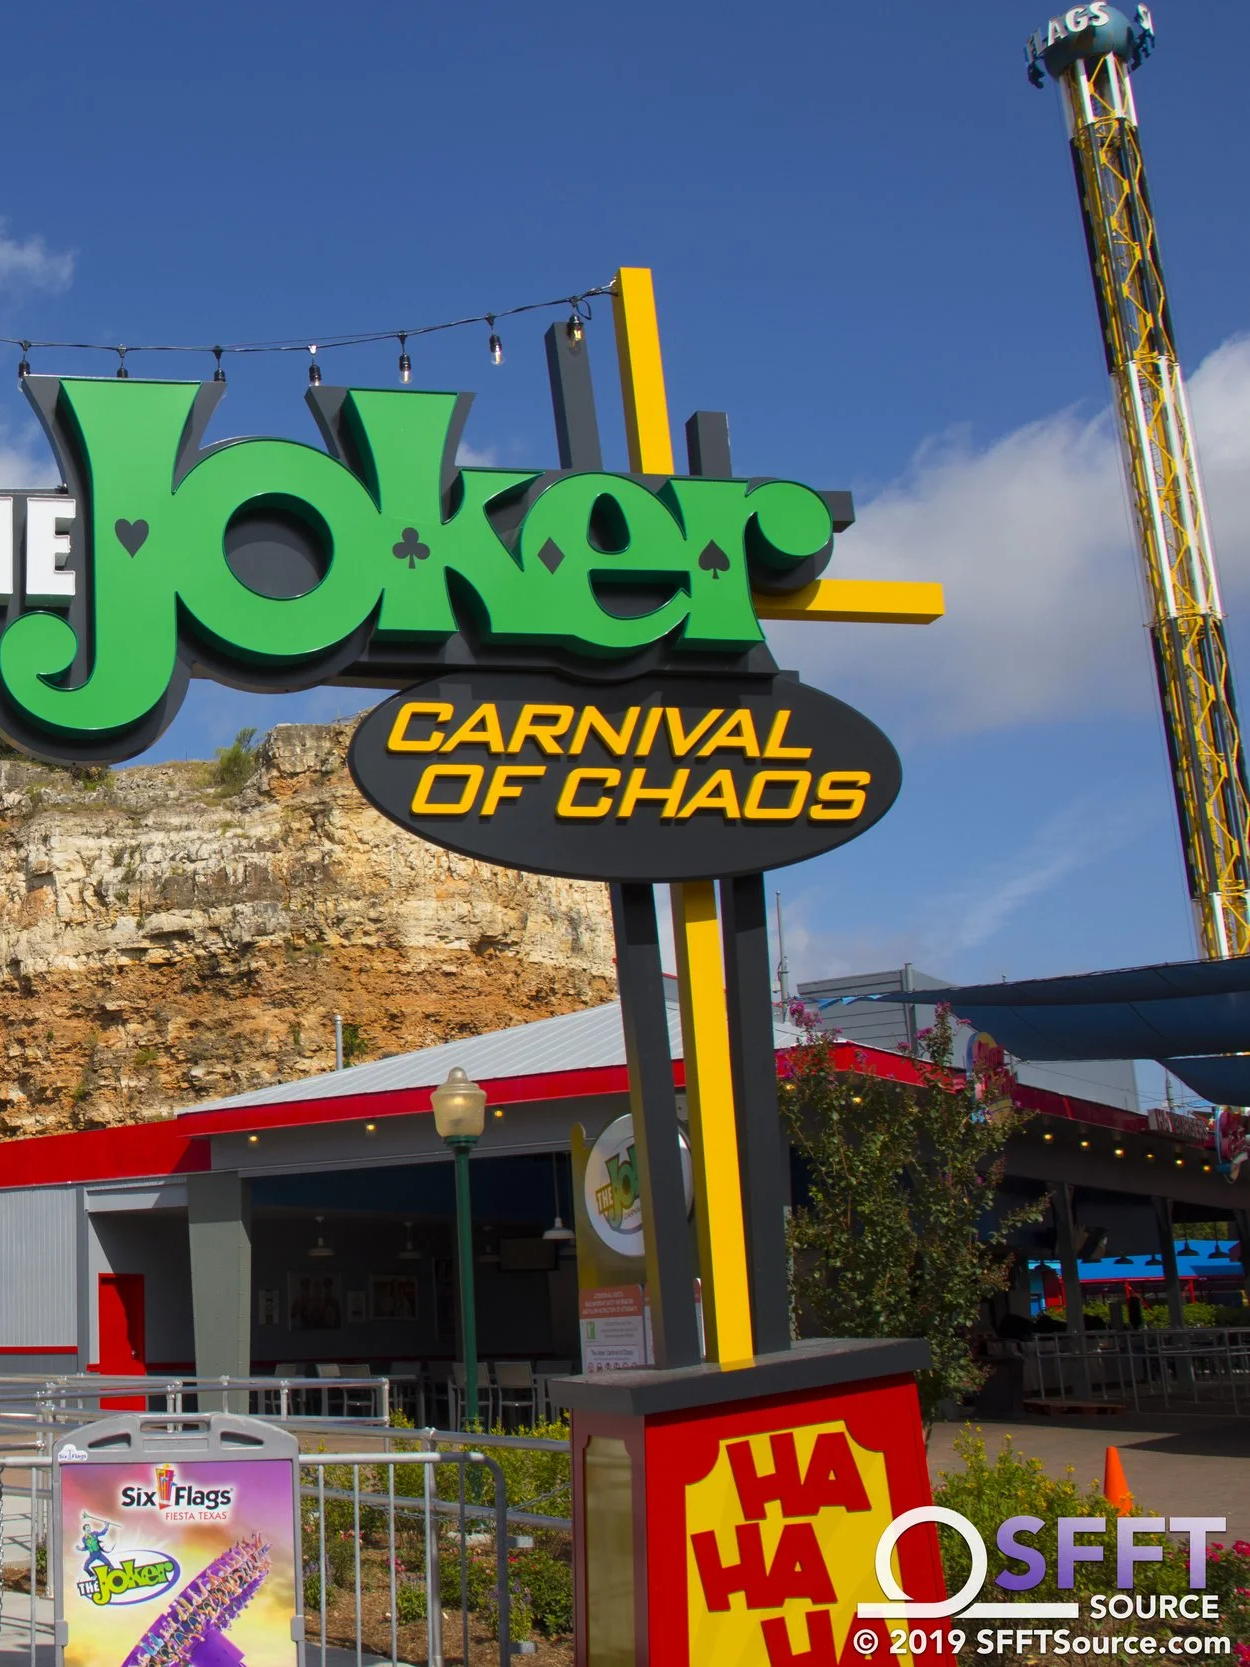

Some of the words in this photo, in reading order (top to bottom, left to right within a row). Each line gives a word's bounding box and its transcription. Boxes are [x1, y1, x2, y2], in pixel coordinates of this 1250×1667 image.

[386, 700, 813, 760] CARNIVAL
[410, 763, 548, 817] OF
[556, 767, 872, 822] CHAOS
[597, 1186, 614, 1213] THE
[121, 1486, 157, 1507] Six
[174, 1486, 231, 1510] Flags
[725, 1430, 872, 1521] HA
[165, 1512, 195, 1520] FIESTA
[199, 1511, 227, 1520] TEXAS
[78, 1580, 100, 1595] THE
[91, 1559, 174, 1605] Joker
[690, 1521, 838, 1613] HA
